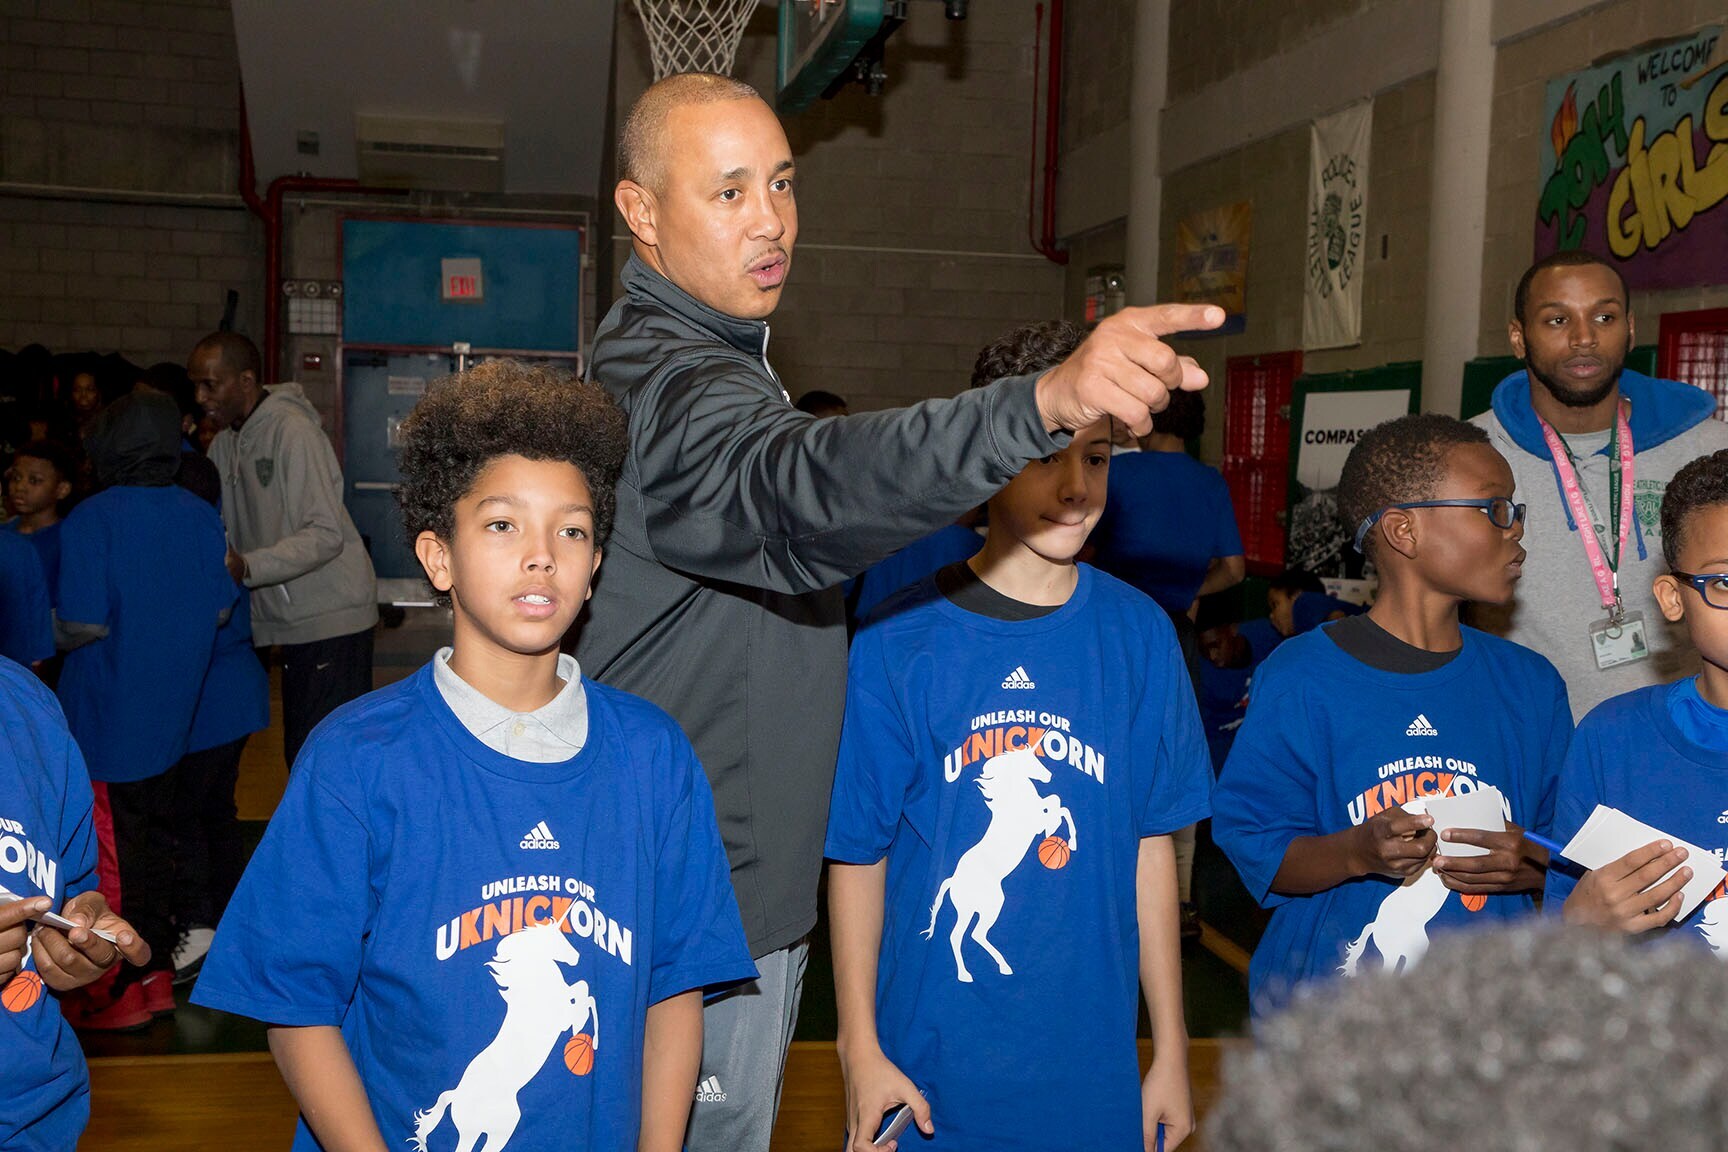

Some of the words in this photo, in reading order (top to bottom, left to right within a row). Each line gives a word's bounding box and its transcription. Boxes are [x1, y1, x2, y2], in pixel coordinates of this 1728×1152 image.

[1660, 83, 1677, 107] TO
[1540, 70, 1628, 251] 2014
[1340, 194, 1362, 290] LEAGUE
[1575, 504, 1587, 522] LIKE
[1580, 522, 1594, 545] FIGHT
[1001, 680, 1036, 690] adidas
[971, 710, 1036, 731] UNLEASH
[1039, 712, 1071, 732] OUR
[1406, 727, 1438, 737] adidas
[944, 725, 1105, 785] UKNICKORN
[1378, 756, 1443, 779] UNLEASH
[1446, 758, 1478, 777] OUR
[519, 838, 560, 850] adidas
[481, 875, 560, 900] UNLEASH
[564, 878, 596, 903] OUR
[436, 895, 633, 966] UKNICKORN
[696, 1091, 727, 1102] didas
